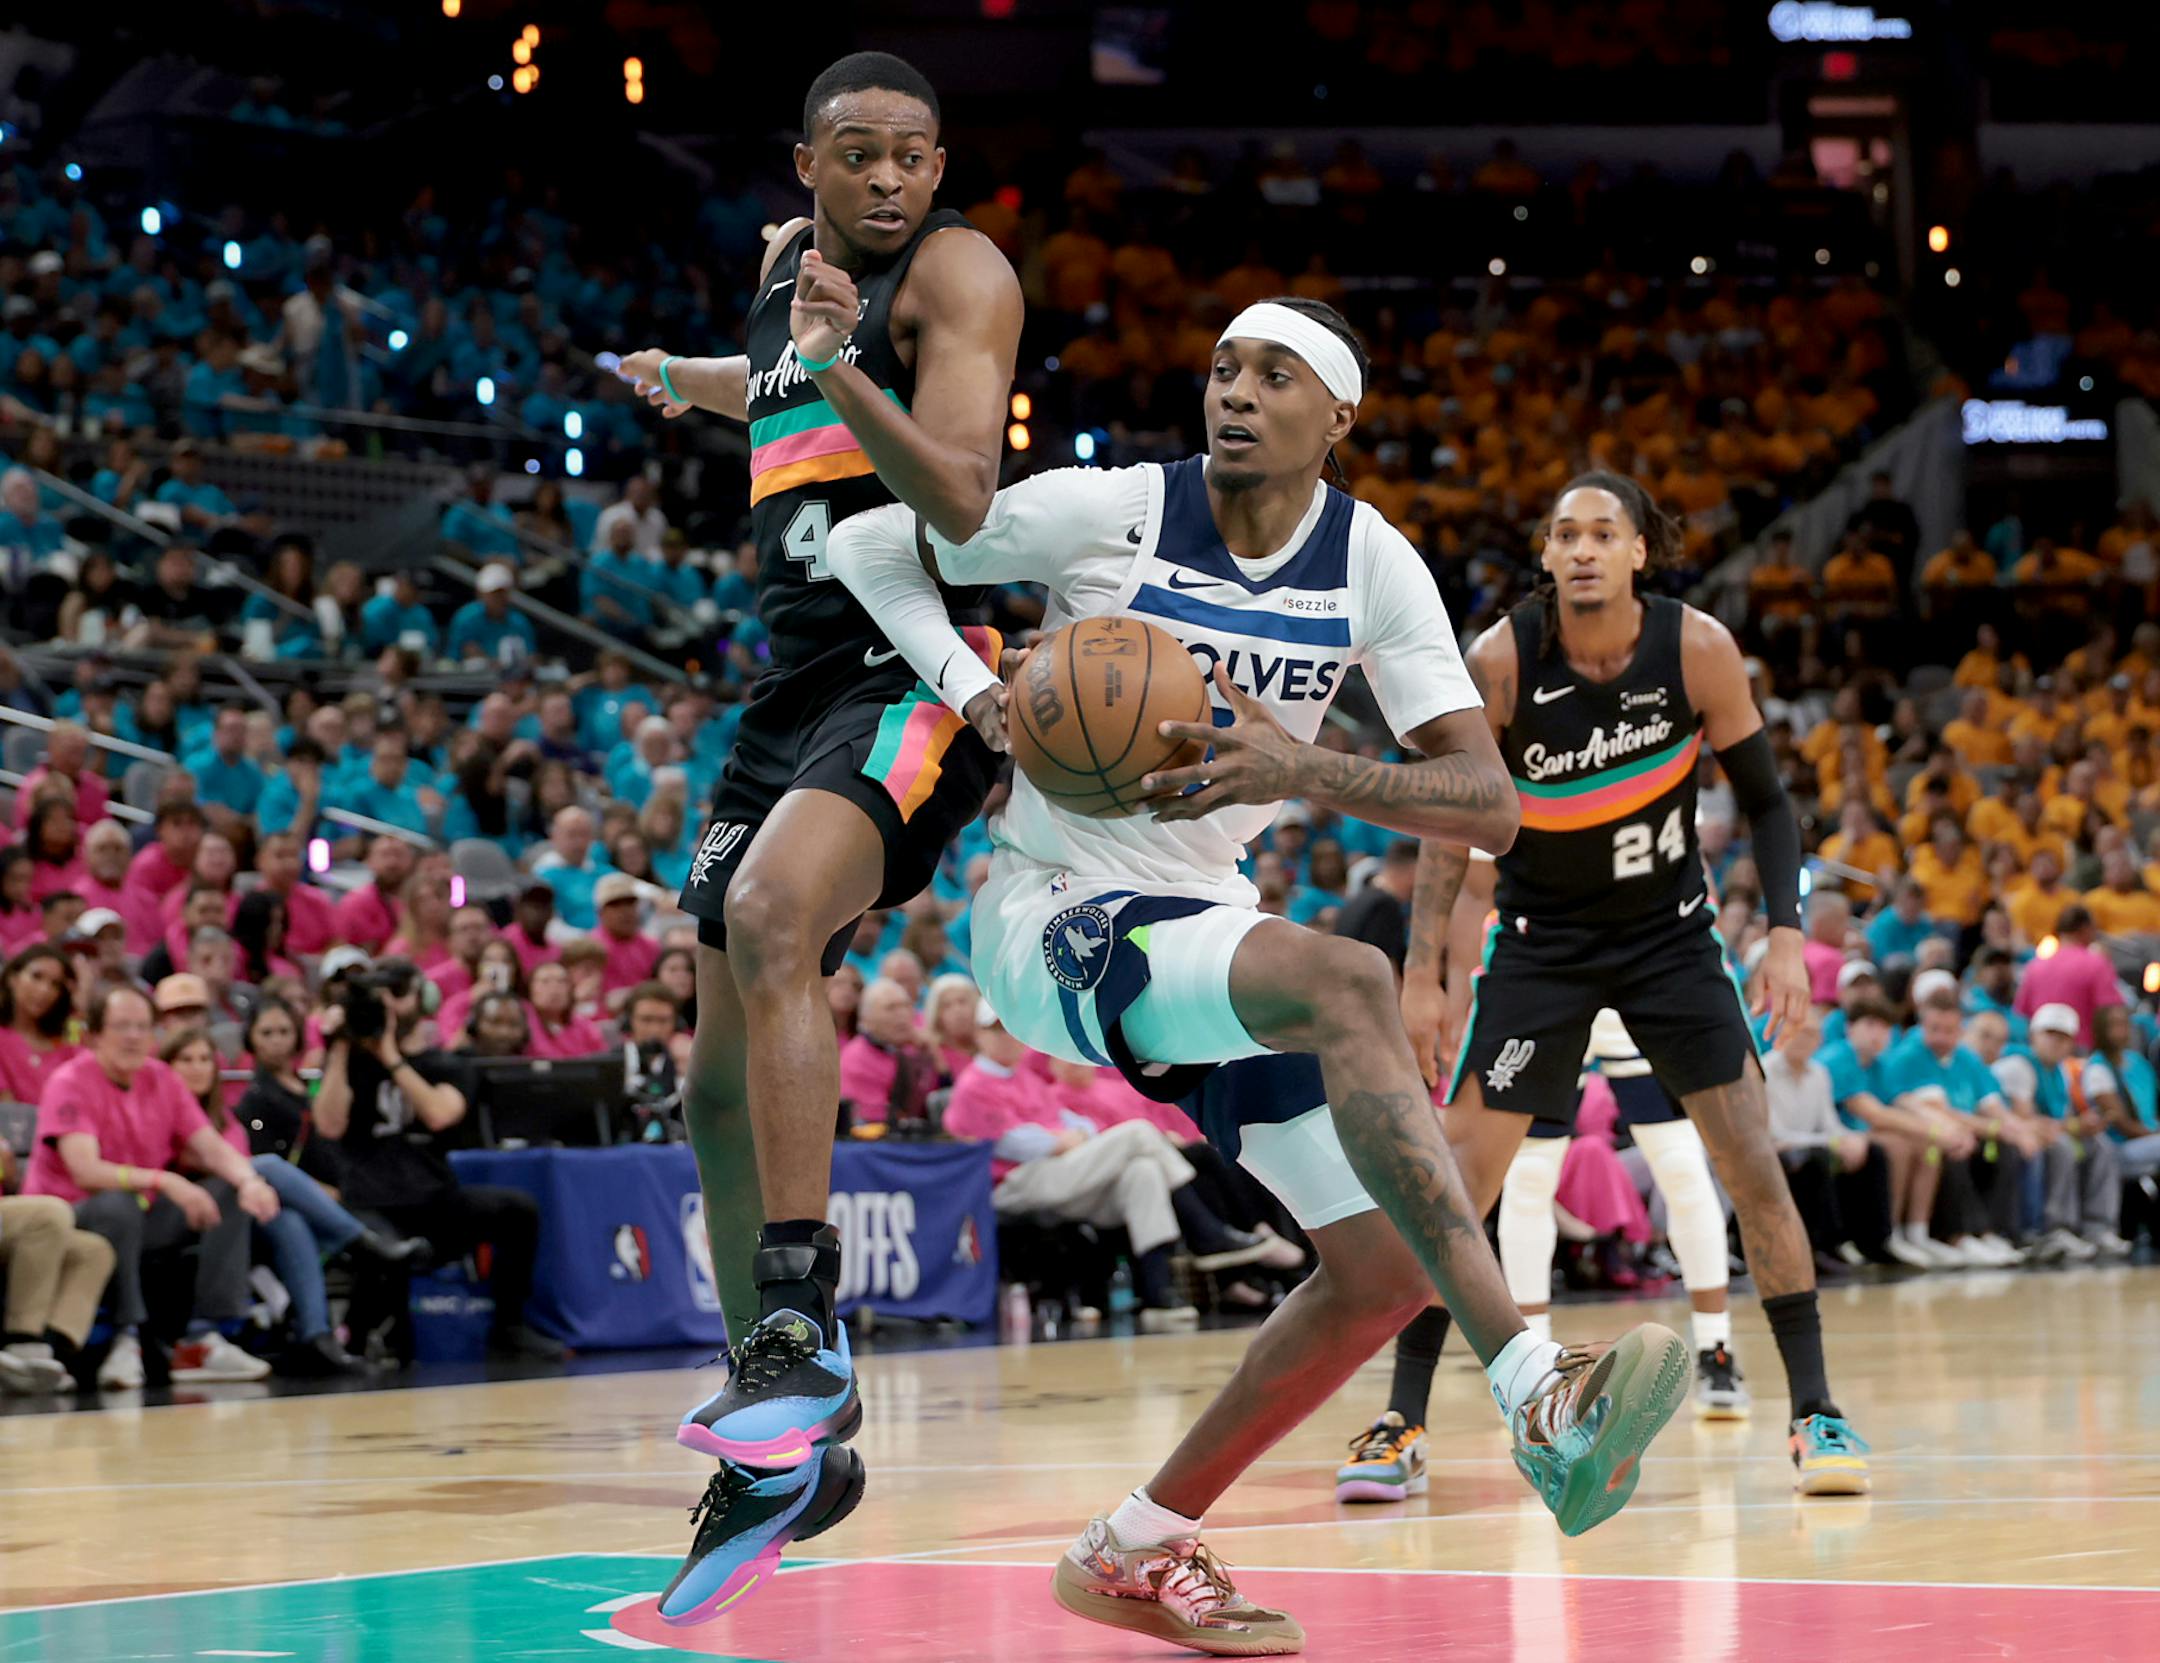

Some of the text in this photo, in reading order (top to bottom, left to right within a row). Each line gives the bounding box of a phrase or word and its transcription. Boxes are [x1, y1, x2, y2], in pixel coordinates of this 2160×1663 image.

[780, 500, 837, 582] 4
[1287, 598, 1337, 612] sezzle
[1176, 638, 1340, 701] OLVES
[1523, 713, 1673, 781] San Antonio
[1612, 805, 1687, 881] 24
[1043, 906, 1110, 990] MINNESOTA TIMBERWOLVES
